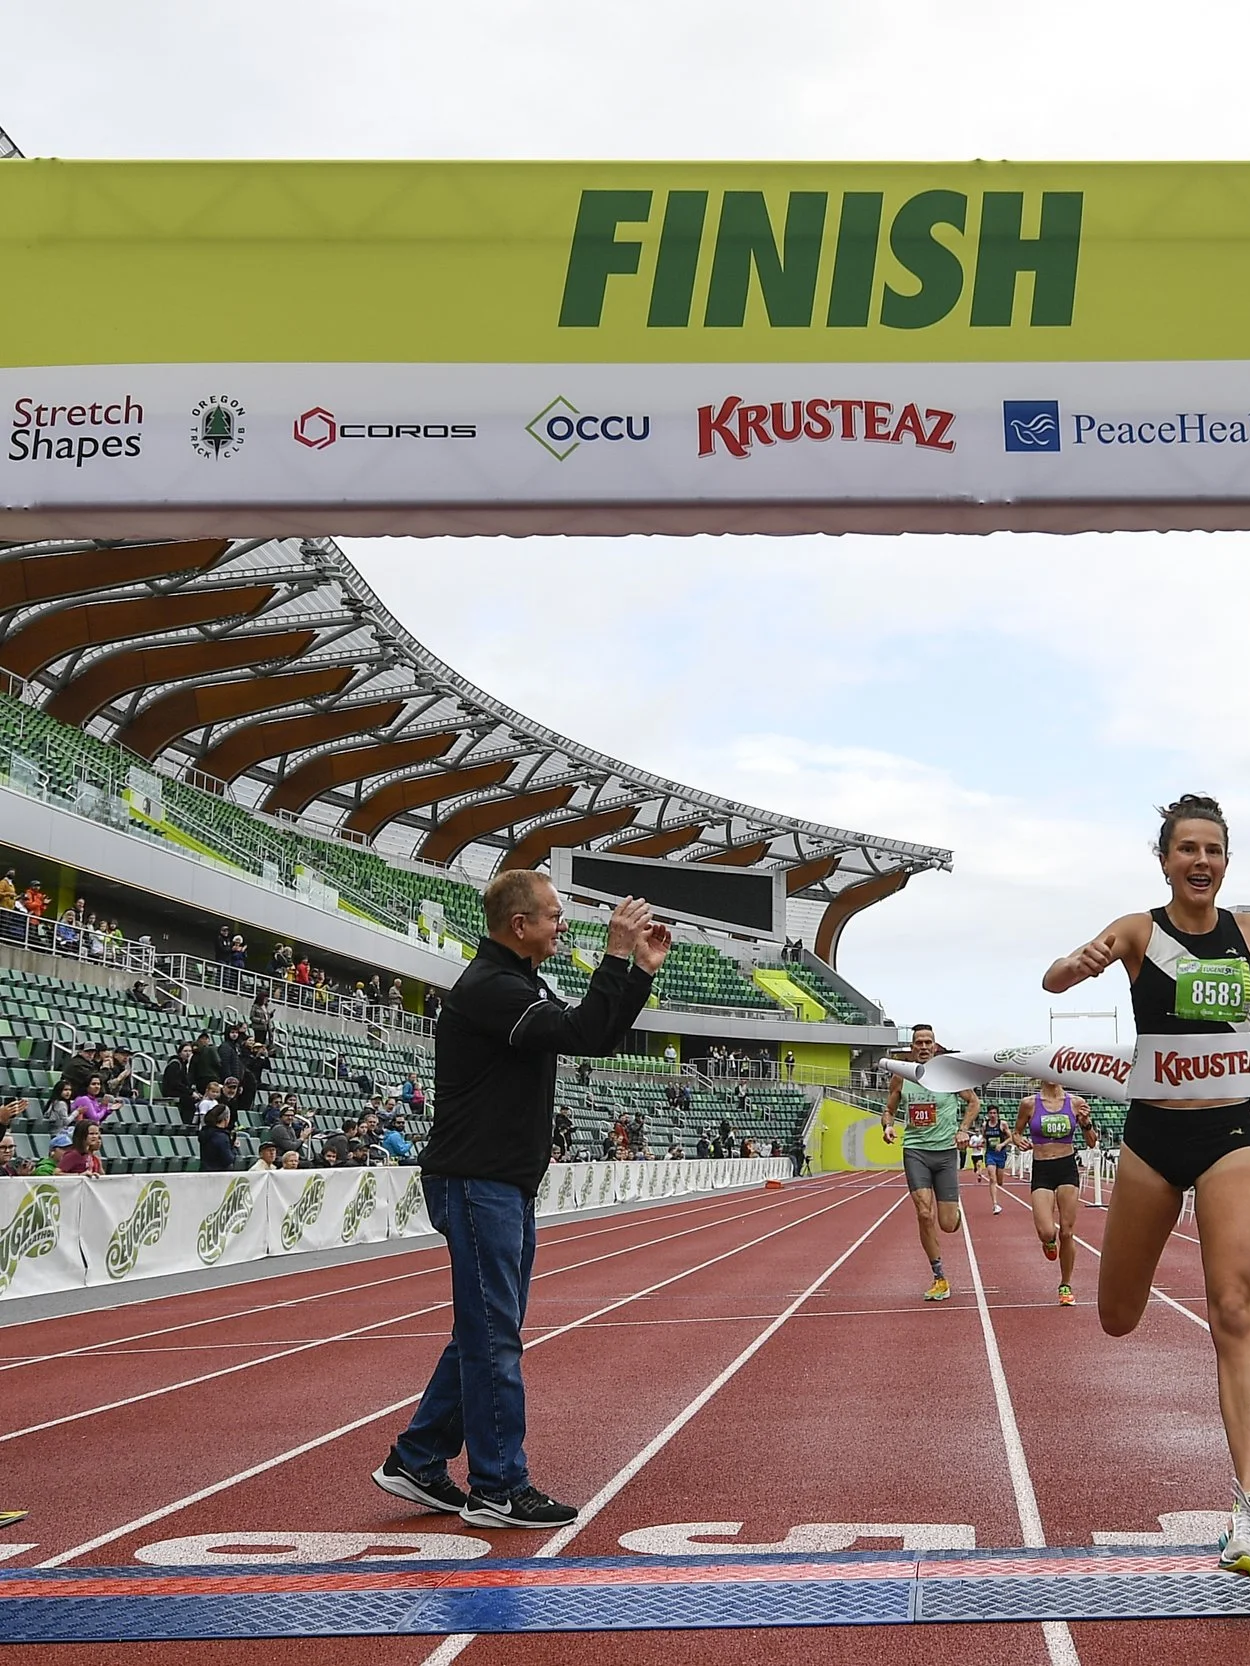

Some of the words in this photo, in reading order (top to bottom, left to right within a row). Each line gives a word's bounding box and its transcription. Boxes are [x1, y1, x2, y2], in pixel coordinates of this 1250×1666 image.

[557, 189, 1084, 330] FINISH
[12, 395, 144, 428] Stretch
[191, 395, 246, 417] OREGON
[190, 427, 212, 459] TRACK
[223, 427, 246, 459] CLUB
[340, 424, 477, 438] COROS
[546, 415, 650, 441] OCCU
[697, 396, 957, 460] KRUSTEAZ
[8, 429, 142, 467] Shapes
[1192, 980, 1241, 1006] 8583
[1049, 1044, 1132, 1085] KRUSTEAZ
[915, 1110, 929, 1120] 201
[1047, 1122, 1067, 1133] 8042
[0, 1194, 53, 1273] UGENE
